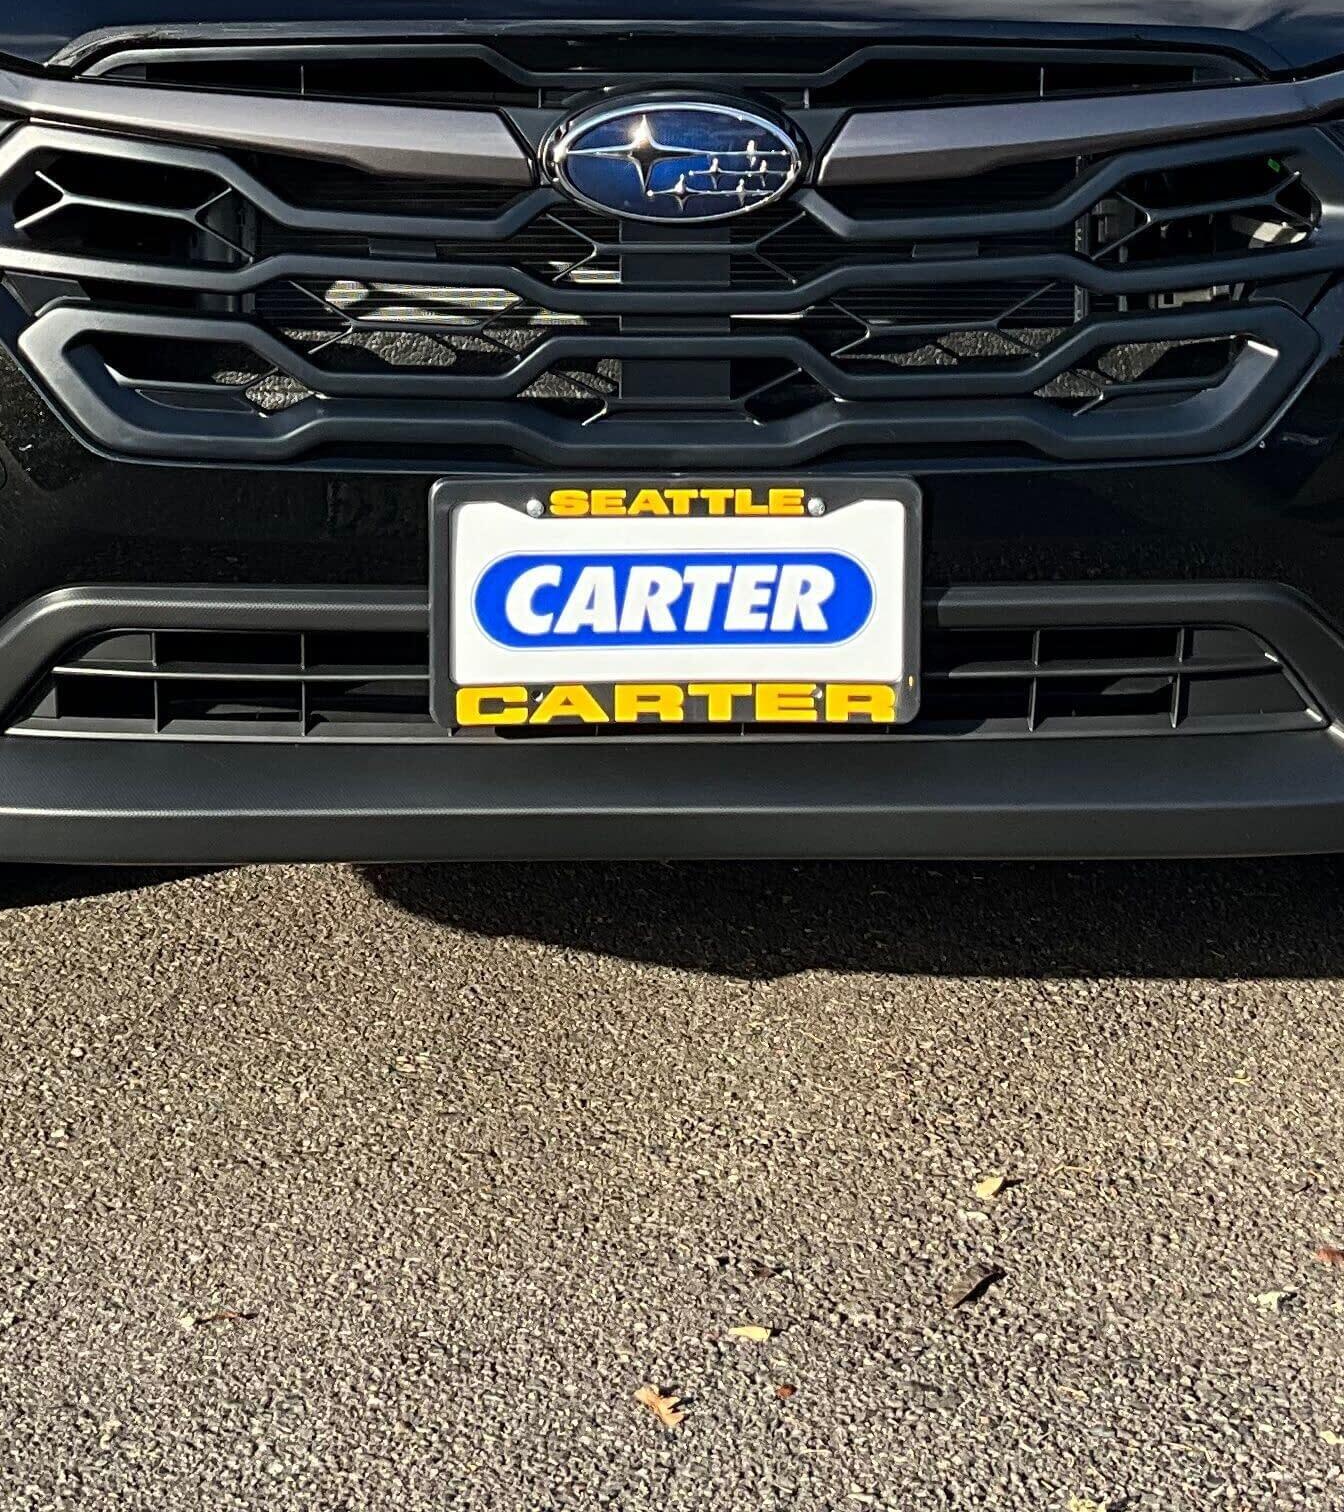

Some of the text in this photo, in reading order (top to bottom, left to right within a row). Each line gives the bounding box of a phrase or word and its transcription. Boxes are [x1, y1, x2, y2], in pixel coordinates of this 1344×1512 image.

[549, 488, 805, 517] SEATTLE
[504, 564, 836, 636] CARTER
[455, 682, 896, 725] CARTER
